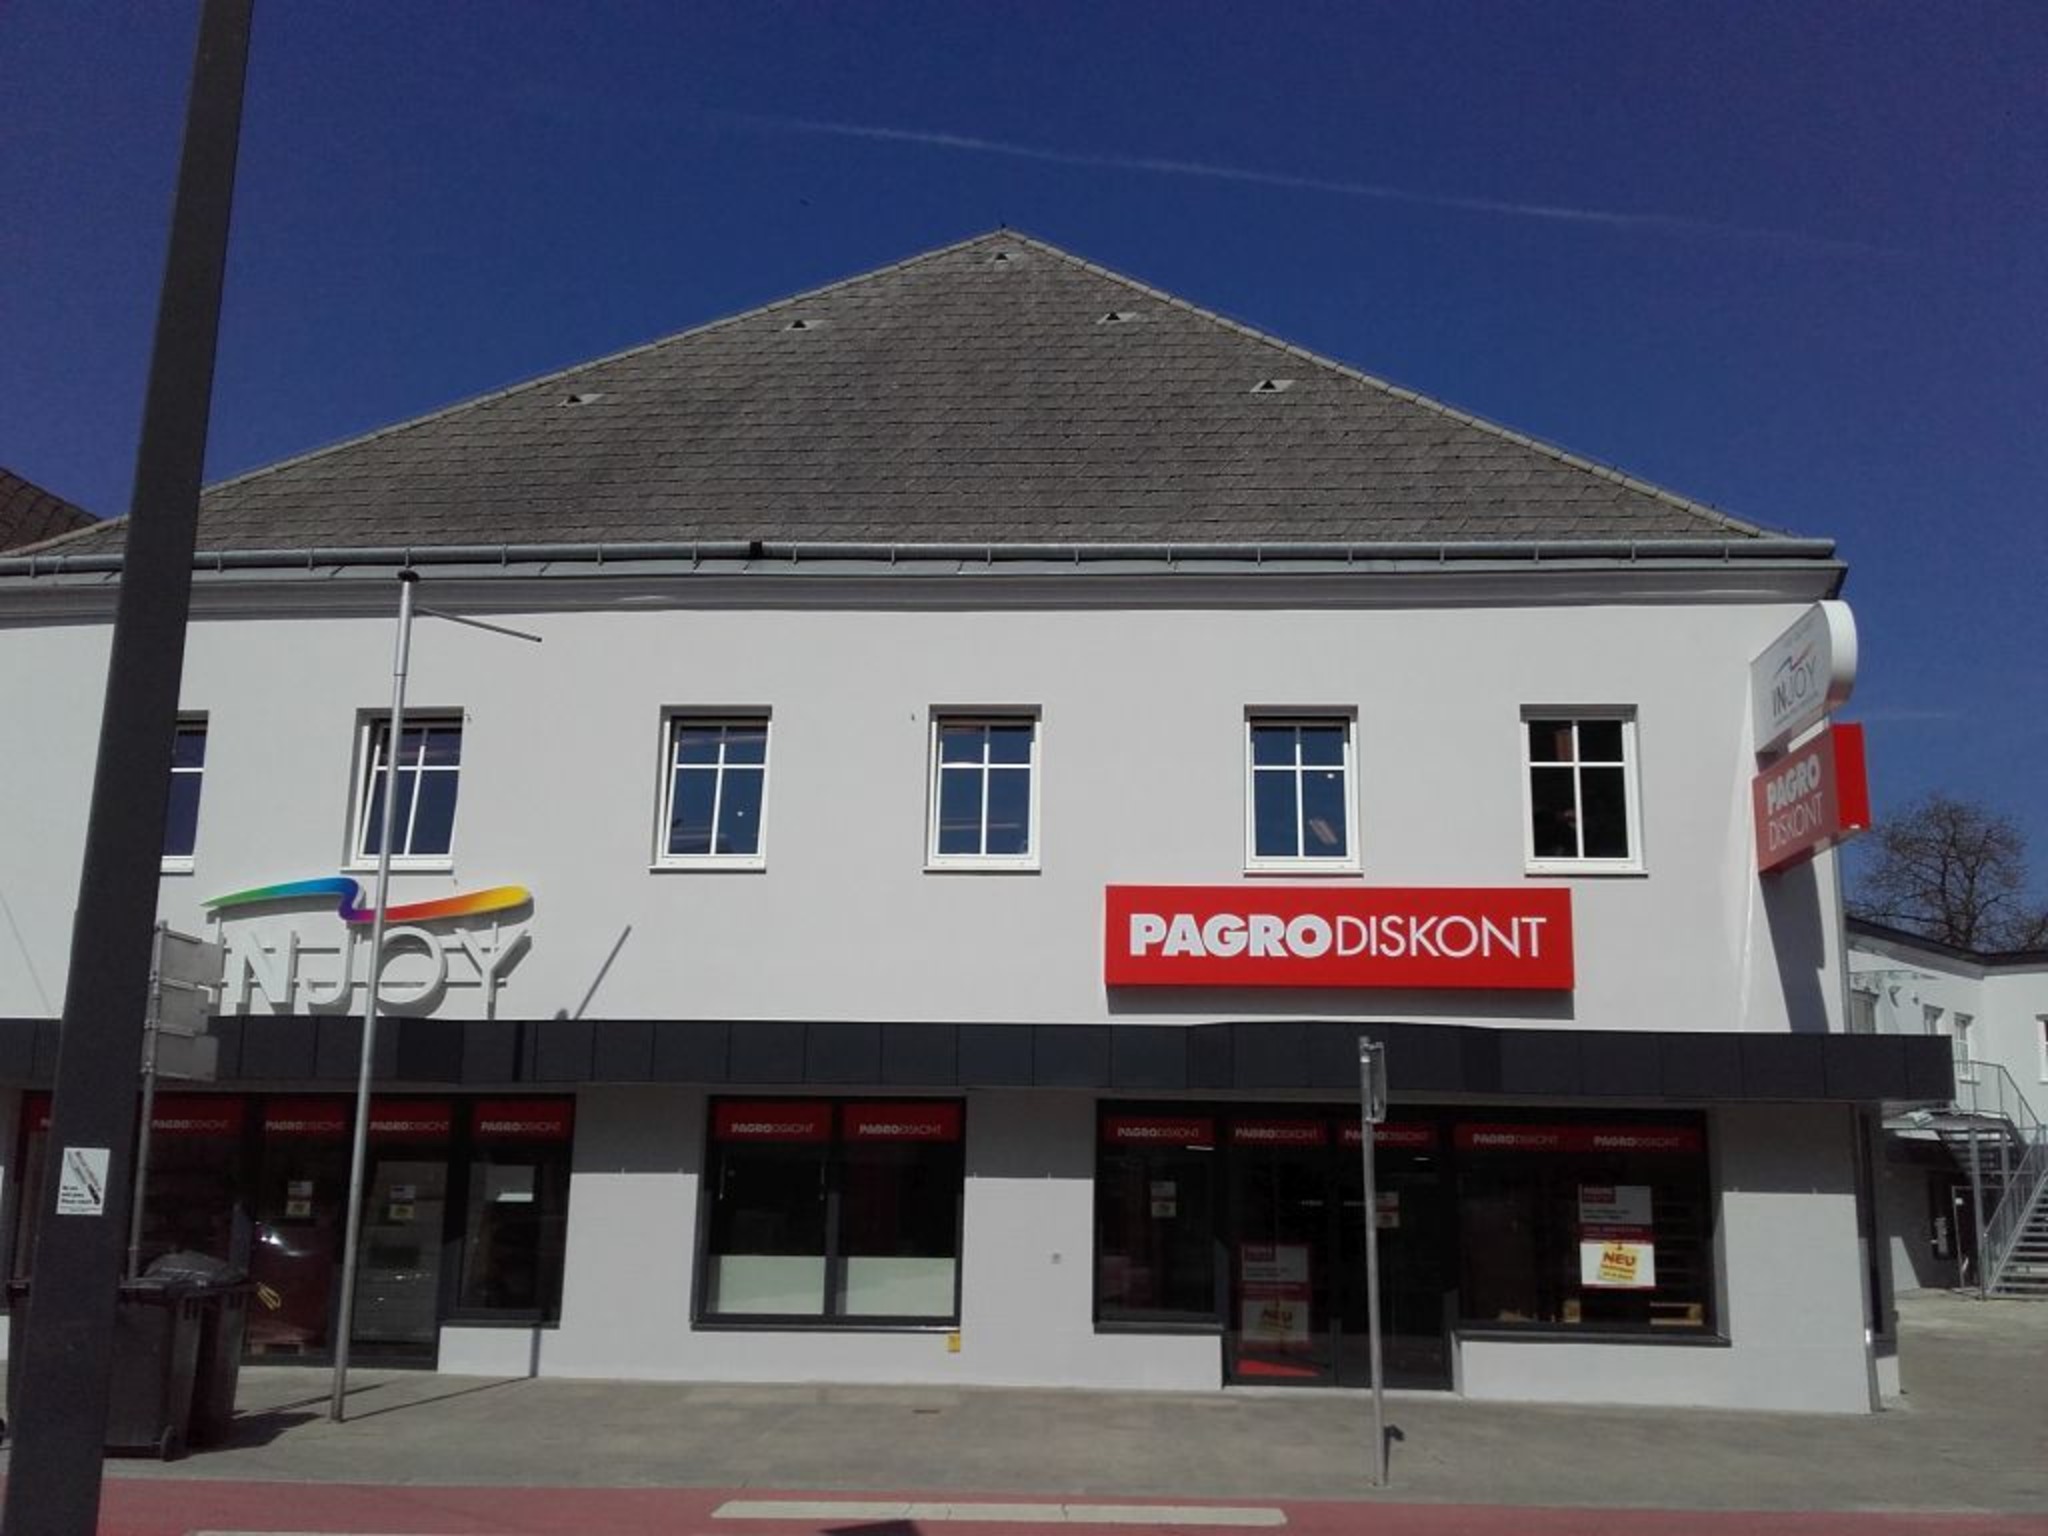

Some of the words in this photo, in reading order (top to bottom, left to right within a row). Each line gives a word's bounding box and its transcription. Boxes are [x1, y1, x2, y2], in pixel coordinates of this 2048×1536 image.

[1771, 655, 1817, 717] INJOY
[1766, 754, 1821, 816] PAGRO
[1768, 792, 1824, 851] DISKONT
[1603, 1251, 1637, 1267] NEU
